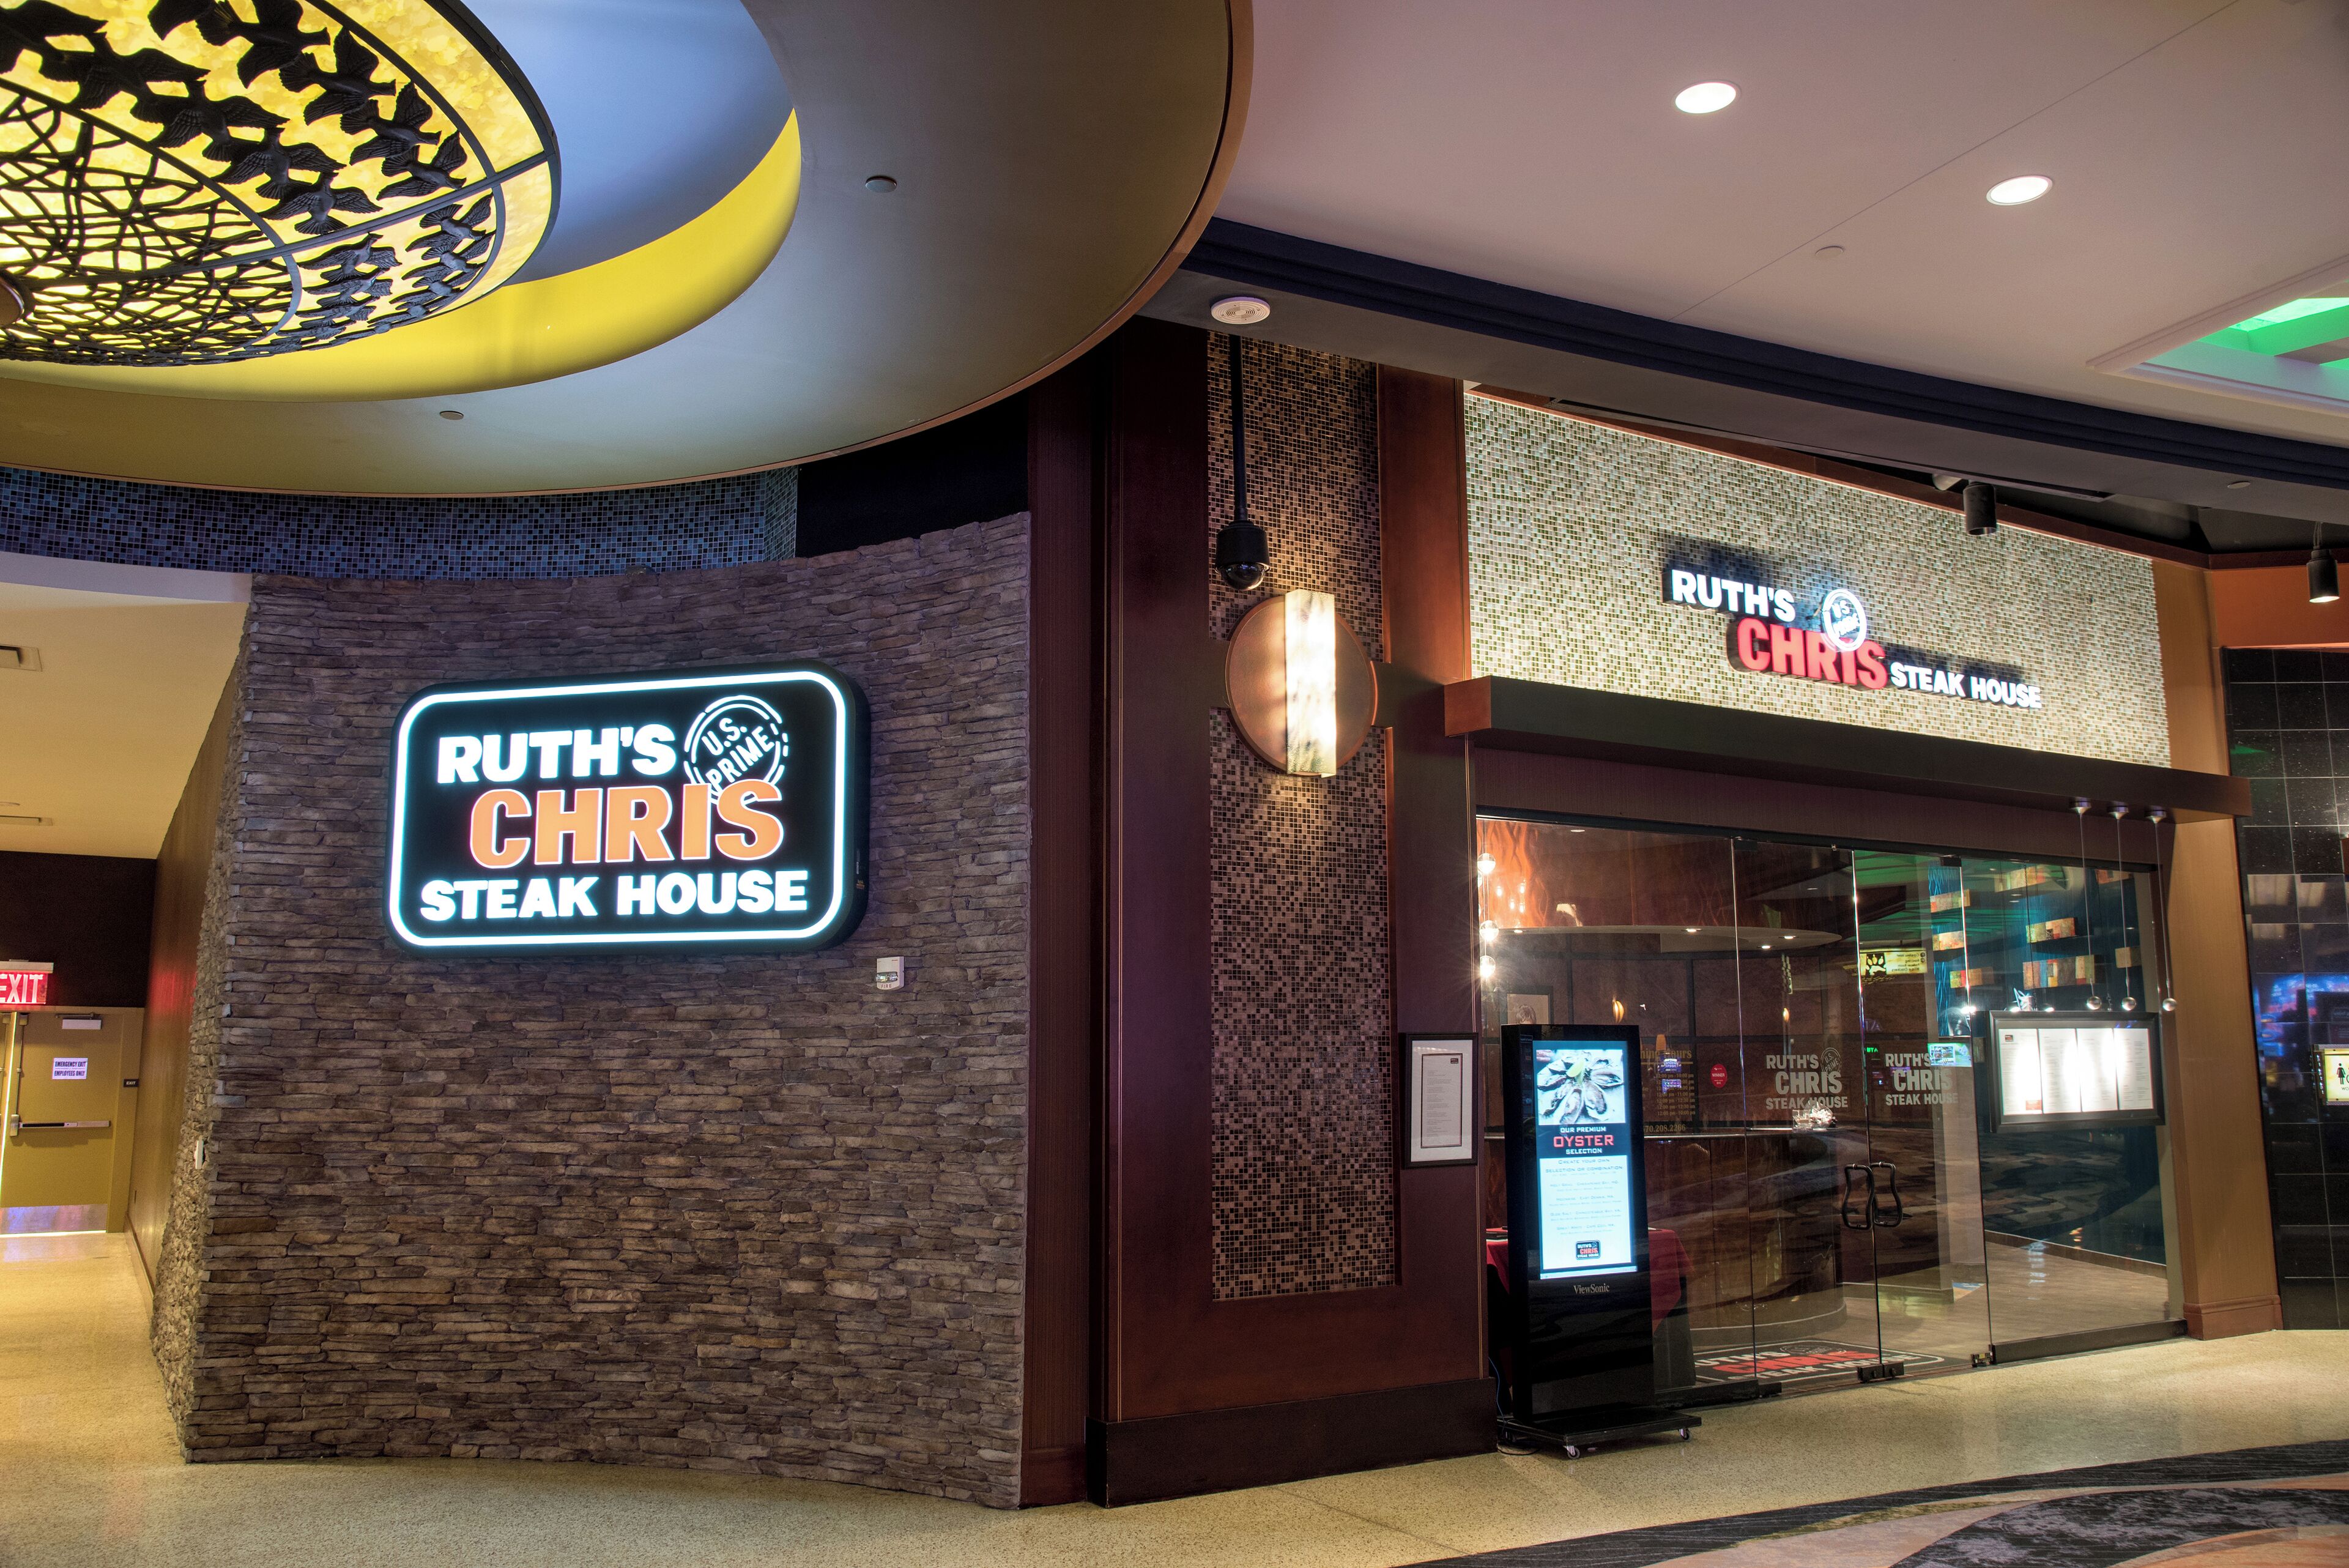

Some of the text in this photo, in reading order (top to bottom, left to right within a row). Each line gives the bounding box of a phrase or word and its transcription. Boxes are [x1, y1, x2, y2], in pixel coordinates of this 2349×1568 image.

[1671, 569, 1796, 622] RUTH'S
[1737, 617, 1888, 690] CHRIS
[1890, 662, 2042, 709] STEAK HOUSE
[702, 718, 748, 756] U.S.
[437, 724, 677, 784] RUTH'S
[705, 726, 775, 793] PRIME
[470, 779, 784, 869] CHRIS
[420, 870, 809, 921] STEAK HOUSE
[0, 973, 43, 1003] EXIT
[1766, 1054, 1819, 1069] RUTH'S
[1885, 1053, 1931, 1067] RUTH'S
[1775, 1071, 1842, 1095] CHRIS
[1893, 1069, 1953, 1091] CHRIS
[1765, 1096, 1849, 1110] STEAK HOUSE
[1885, 1093, 1959, 1106] STEAK HOUSE
[1644, 1124, 1686, 1133] 70.208.2266
[1553, 1134, 1614, 1148] OYSTER
[1573, 1283, 1610, 1295] ViewSonic
[1713, 1350, 1880, 1373] CHRIS
[1727, 1365, 1829, 1380] STEAK
